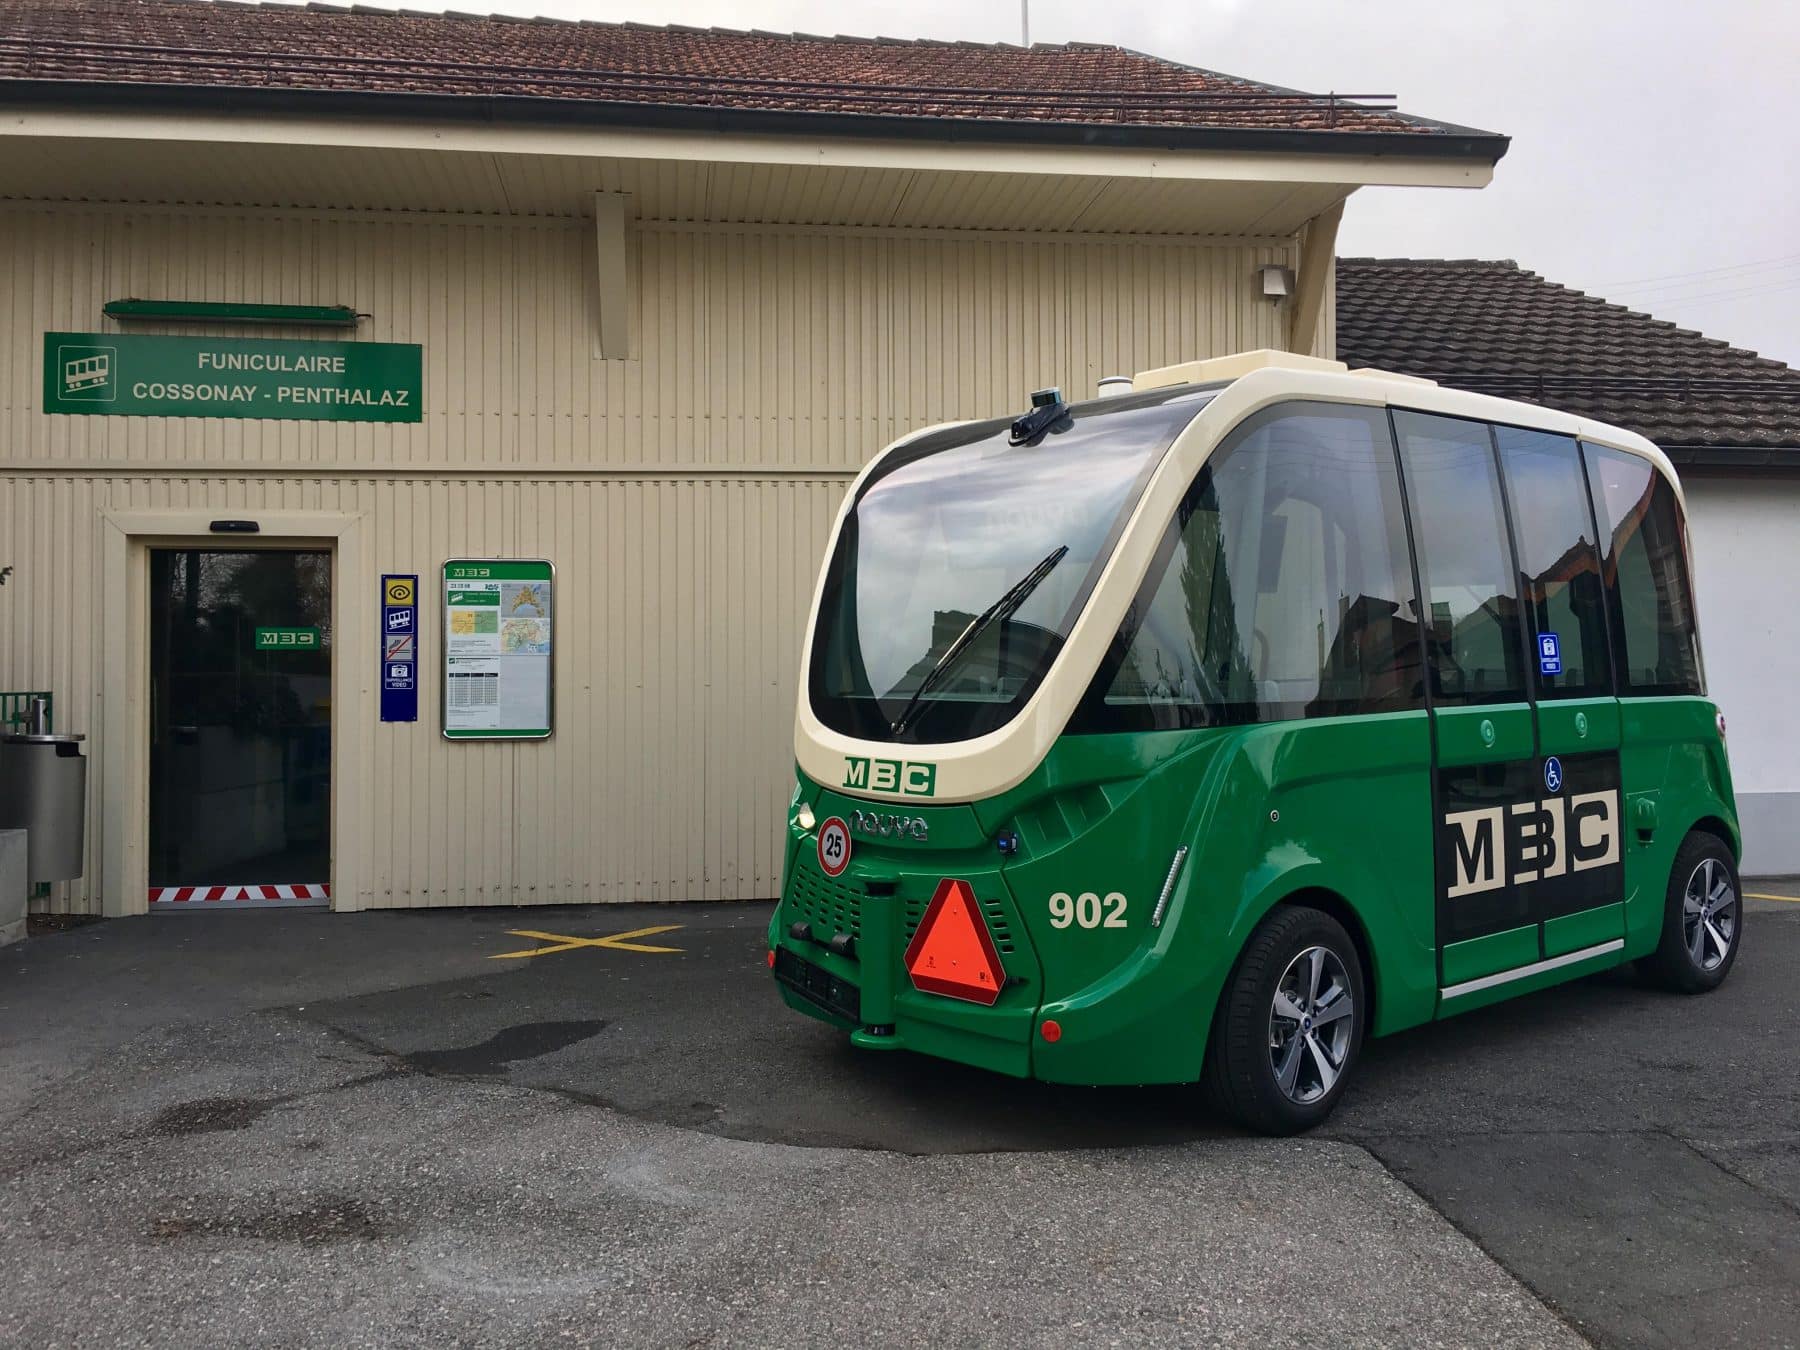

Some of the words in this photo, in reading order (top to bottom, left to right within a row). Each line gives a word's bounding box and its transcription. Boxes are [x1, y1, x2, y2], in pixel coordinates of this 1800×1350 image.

[198, 352, 346, 373] FUNICULAIRE
[132, 382, 257, 402] COSSONAY
[277, 386, 409, 406] PENTHALAZ
[260, 632, 314, 645] MBC
[842, 756, 937, 797] MBC
[825, 832, 843, 858] 25
[1445, 789, 1620, 898] MBC
[1048, 891, 1129, 929] 902
